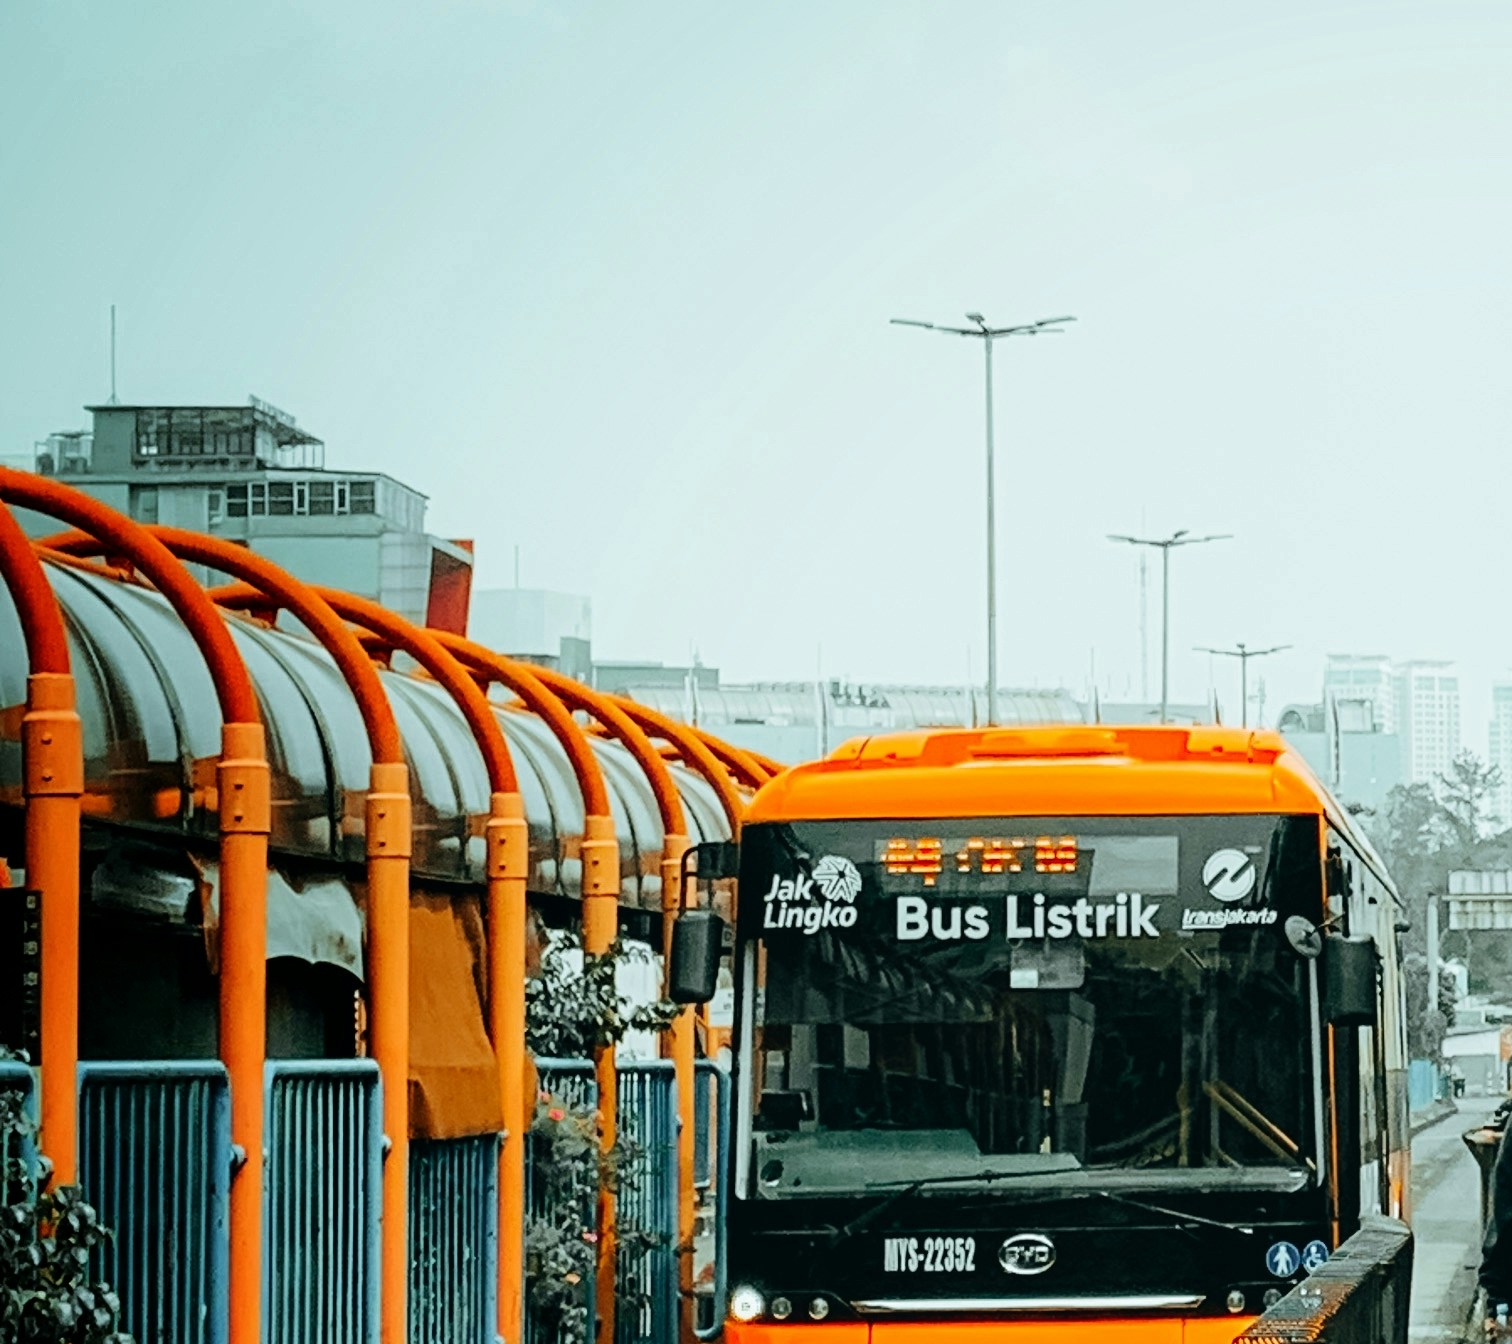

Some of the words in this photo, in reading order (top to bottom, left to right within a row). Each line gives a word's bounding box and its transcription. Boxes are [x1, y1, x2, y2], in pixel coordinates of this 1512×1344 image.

[763, 872, 815, 902] Jak
[763, 900, 858, 935] Lingko
[896, 895, 990, 941] Bus
[1006, 892, 1161, 939] Listrik
[1182, 907, 1278, 930] transjakarta
[884, 1236, 976, 1273] MYS-22352
[1004, 1245, 1050, 1265] BYD
